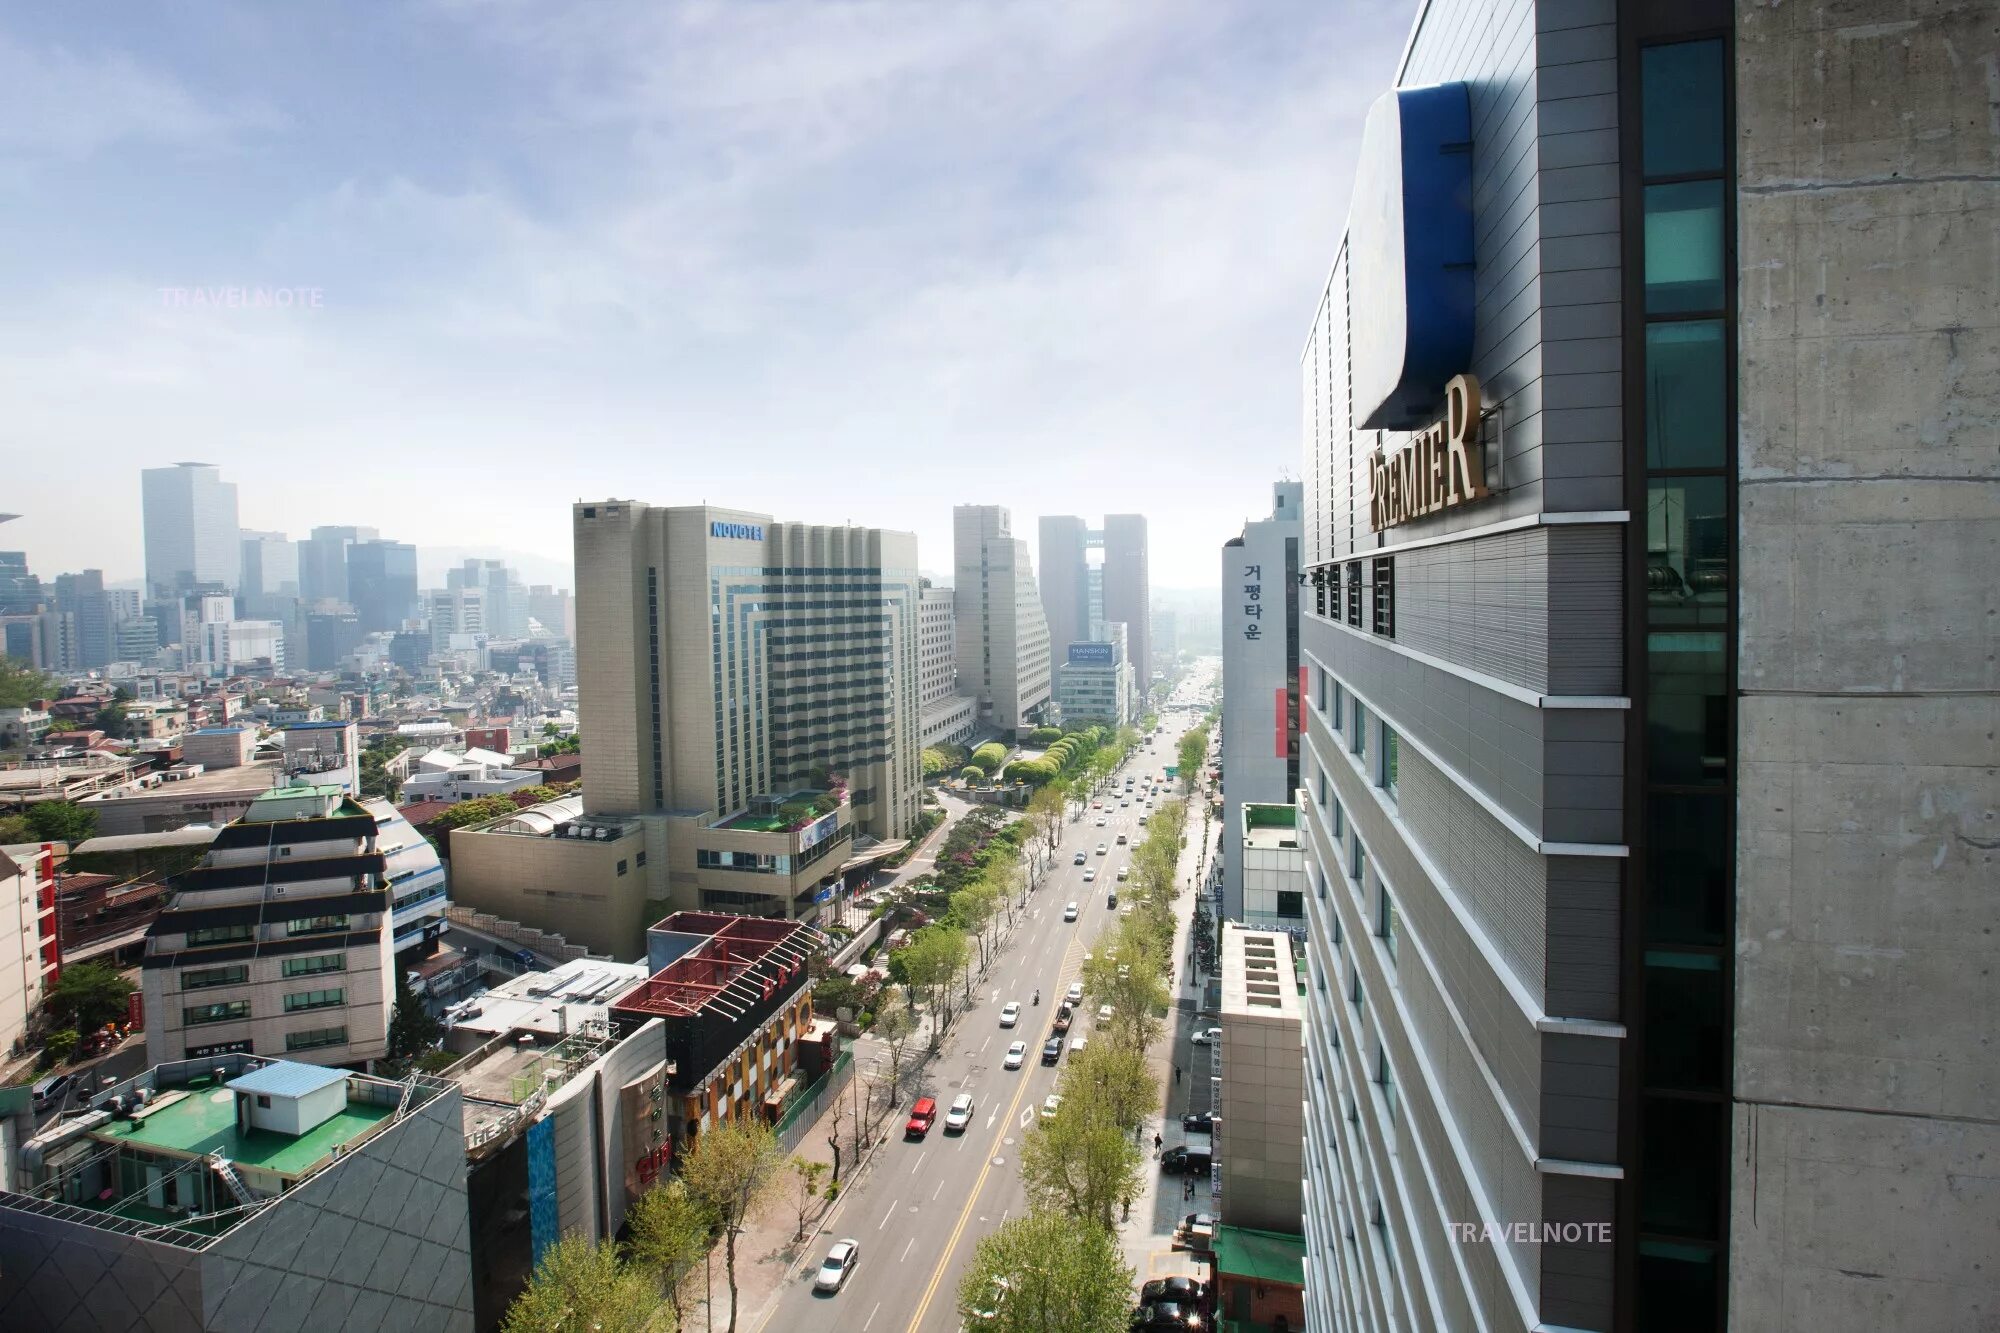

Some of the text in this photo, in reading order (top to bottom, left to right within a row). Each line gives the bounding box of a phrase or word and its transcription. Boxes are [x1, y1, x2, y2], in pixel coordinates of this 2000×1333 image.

[1369, 374, 1482, 532] PREMIER
[711, 521, 765, 541] NOVOTEL
[1244, 564, 1262, 640] 거평타운
